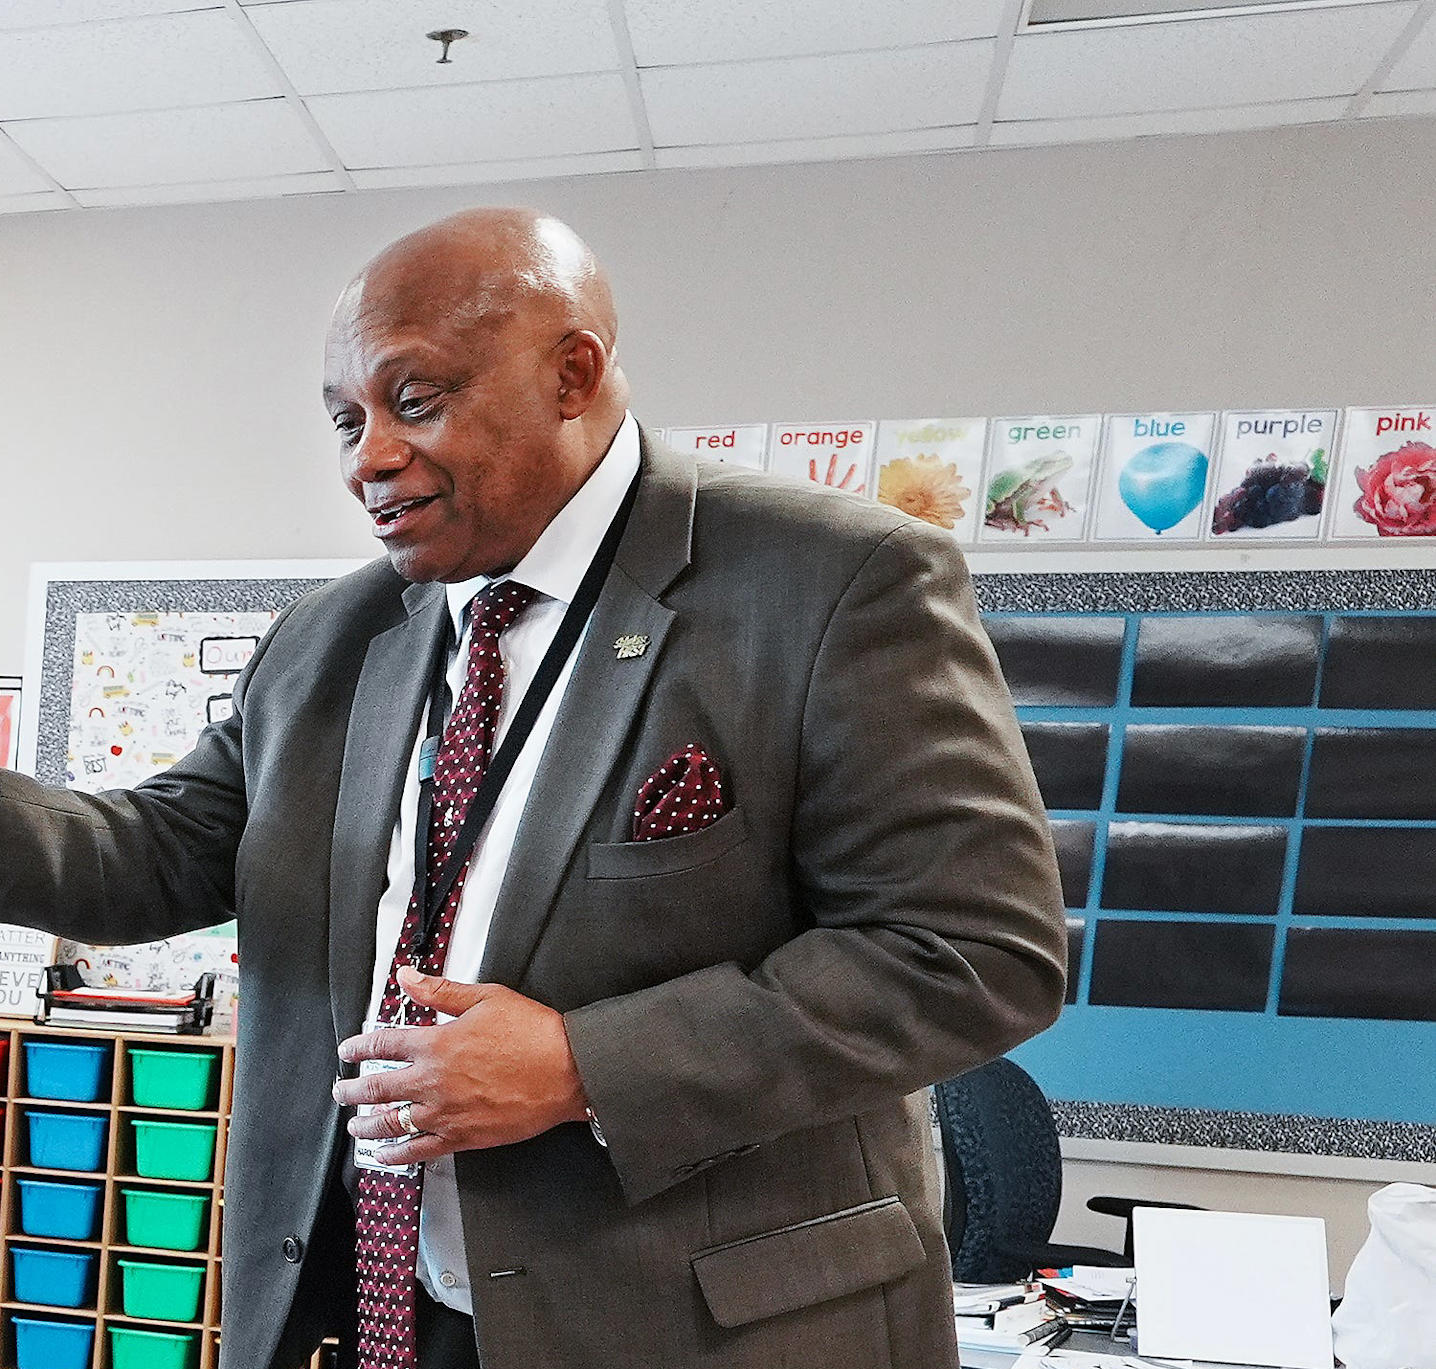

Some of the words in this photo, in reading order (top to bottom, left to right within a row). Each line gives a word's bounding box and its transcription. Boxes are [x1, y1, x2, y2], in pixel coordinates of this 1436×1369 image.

[1007, 422, 1082, 444] green
[1133, 418, 1187, 437] blue
[1235, 414, 1323, 439] purple
[1375, 412, 1433, 436] pink
[695, 430, 736, 449] red
[780, 428, 864, 449] orange
